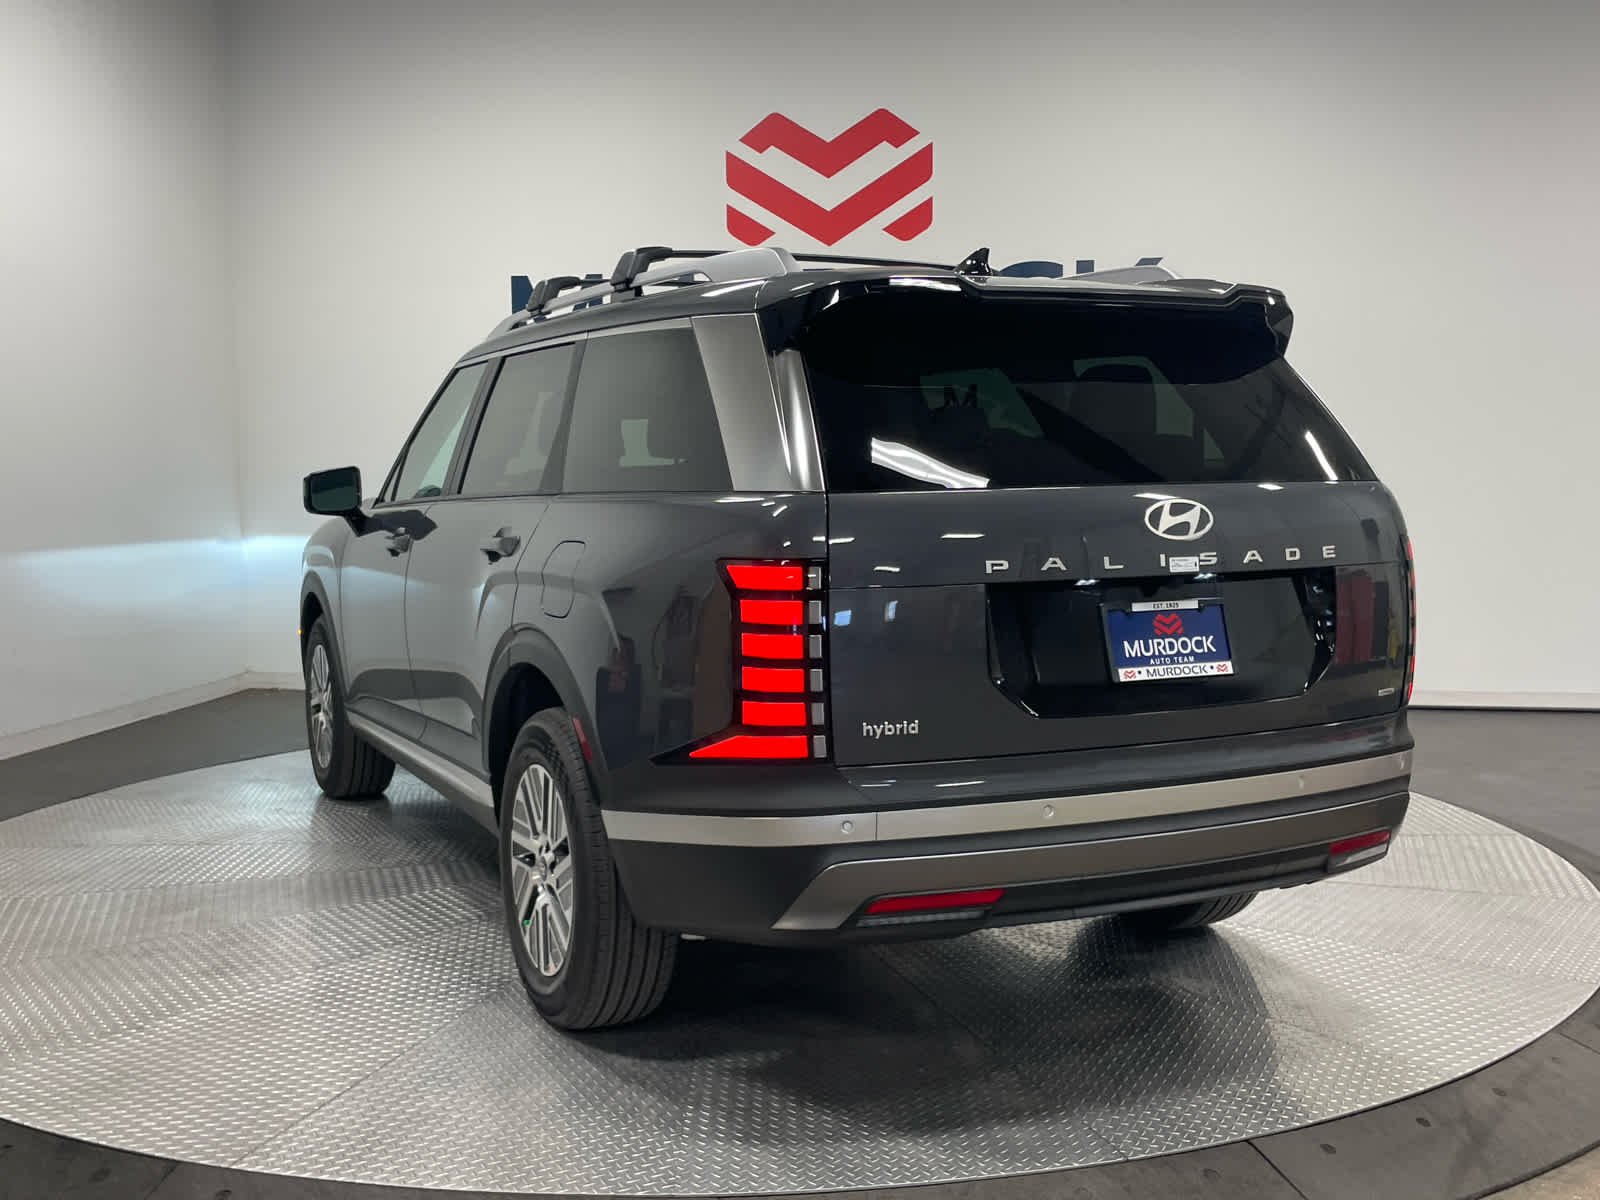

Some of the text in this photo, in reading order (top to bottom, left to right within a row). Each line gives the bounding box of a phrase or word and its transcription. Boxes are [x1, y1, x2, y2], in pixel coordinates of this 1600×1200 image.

[985, 545, 1336, 574] PALISADE
[1123, 635, 1216, 658] MURDOCK
[1150, 657, 1171, 665] AUTO
[1146, 665, 1208, 678] MURDOCK
[862, 720, 919, 739] hybrid
